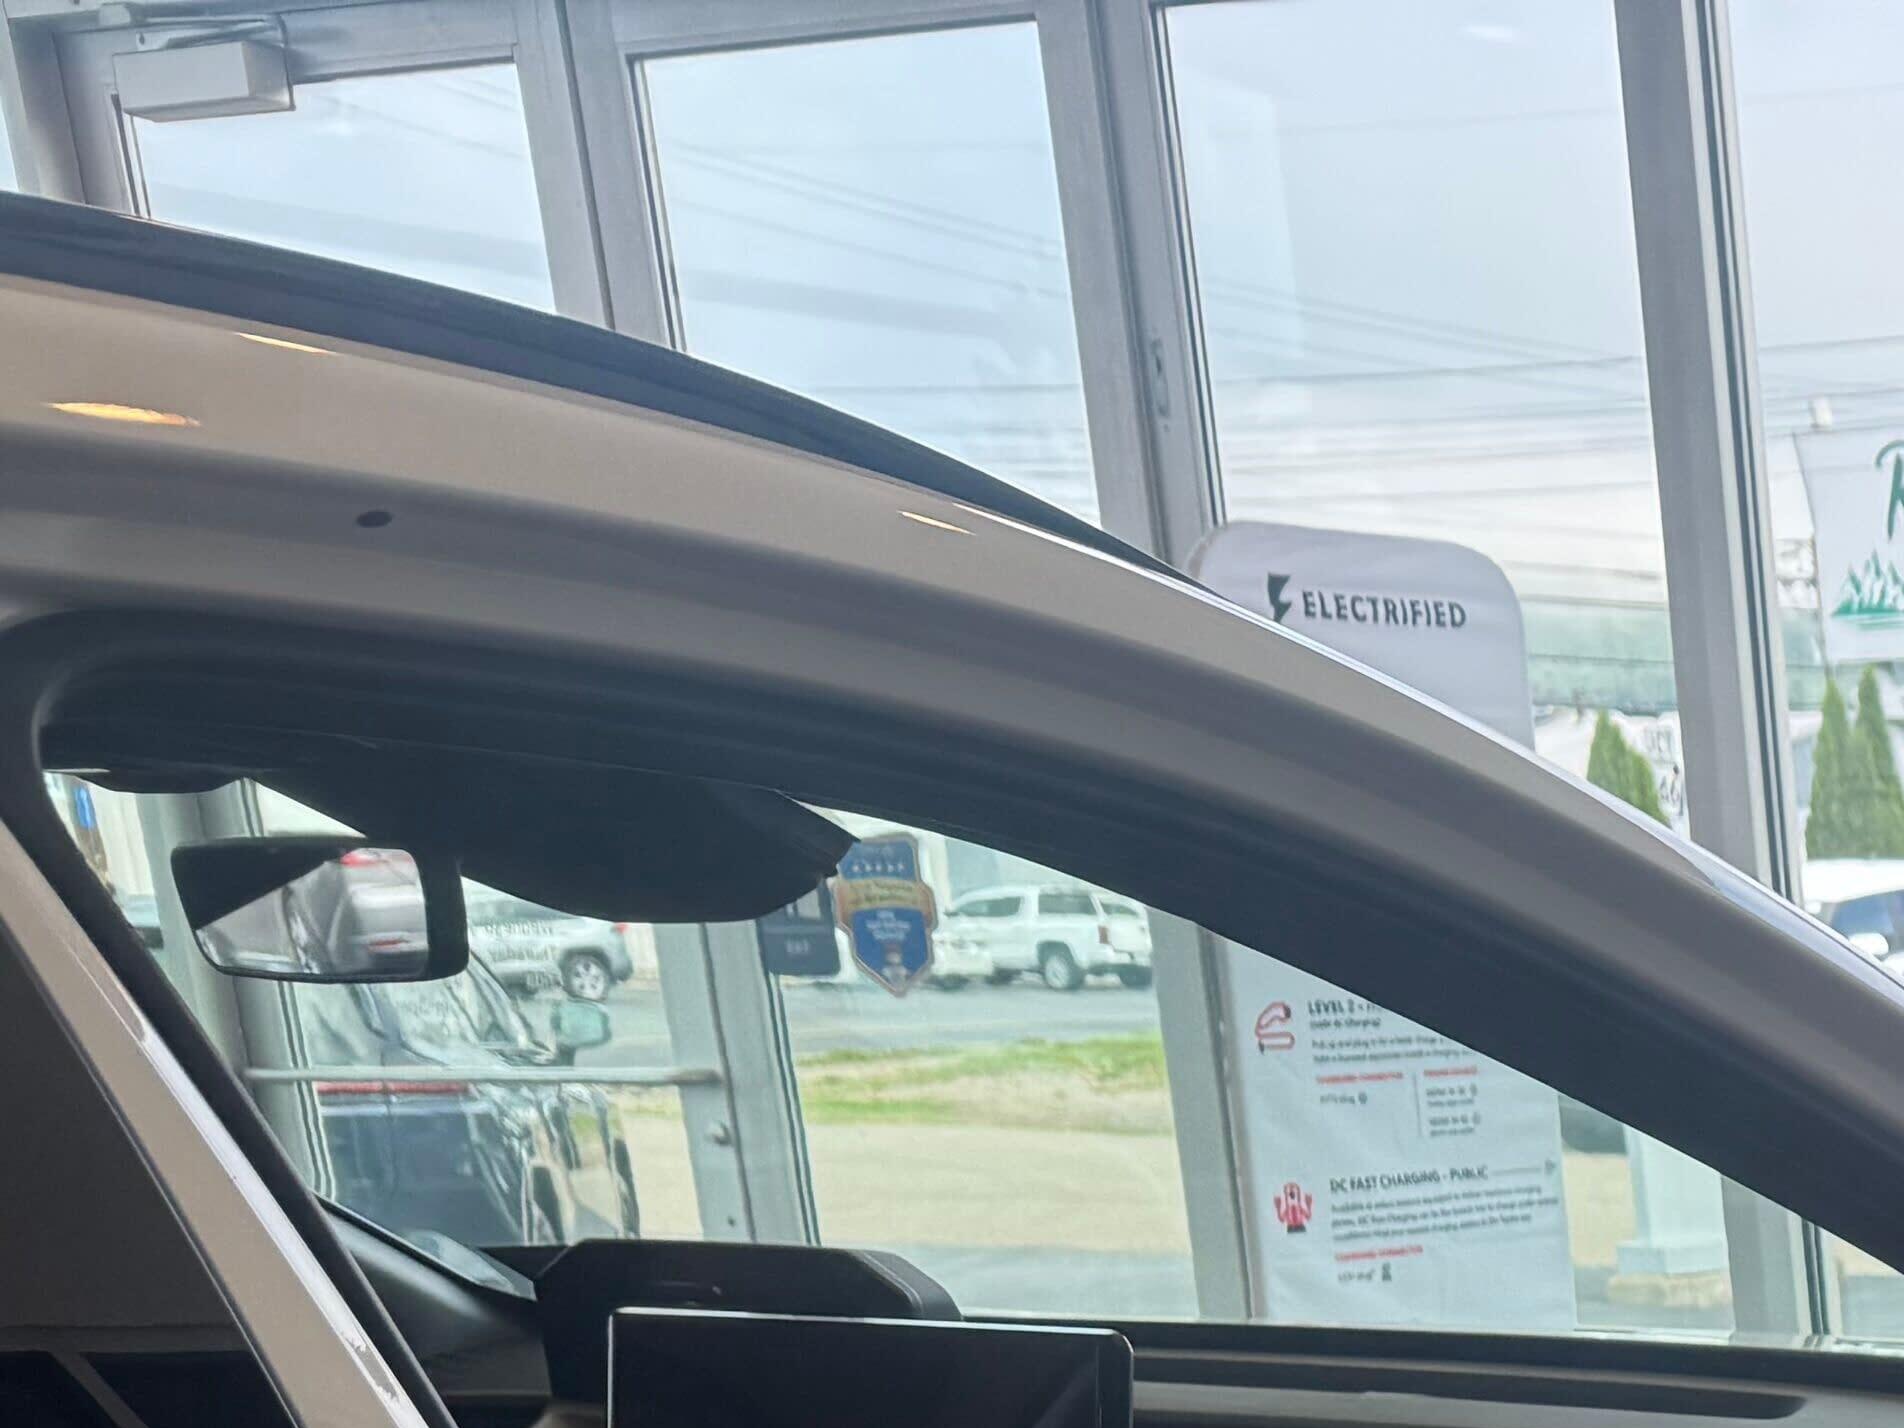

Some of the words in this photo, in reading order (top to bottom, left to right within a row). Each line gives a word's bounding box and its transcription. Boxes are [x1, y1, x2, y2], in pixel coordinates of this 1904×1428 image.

[1302, 589, 1466, 628] ELECTRIFIED
[1307, 999, 1344, 1015] LEVEL
[1329, 1177, 1348, 1193] DC
[1350, 1174, 1377, 1191] FAST
[1379, 1169, 1441, 1189] CHARGING
[1450, 1164, 1489, 1181] PUBLIC
